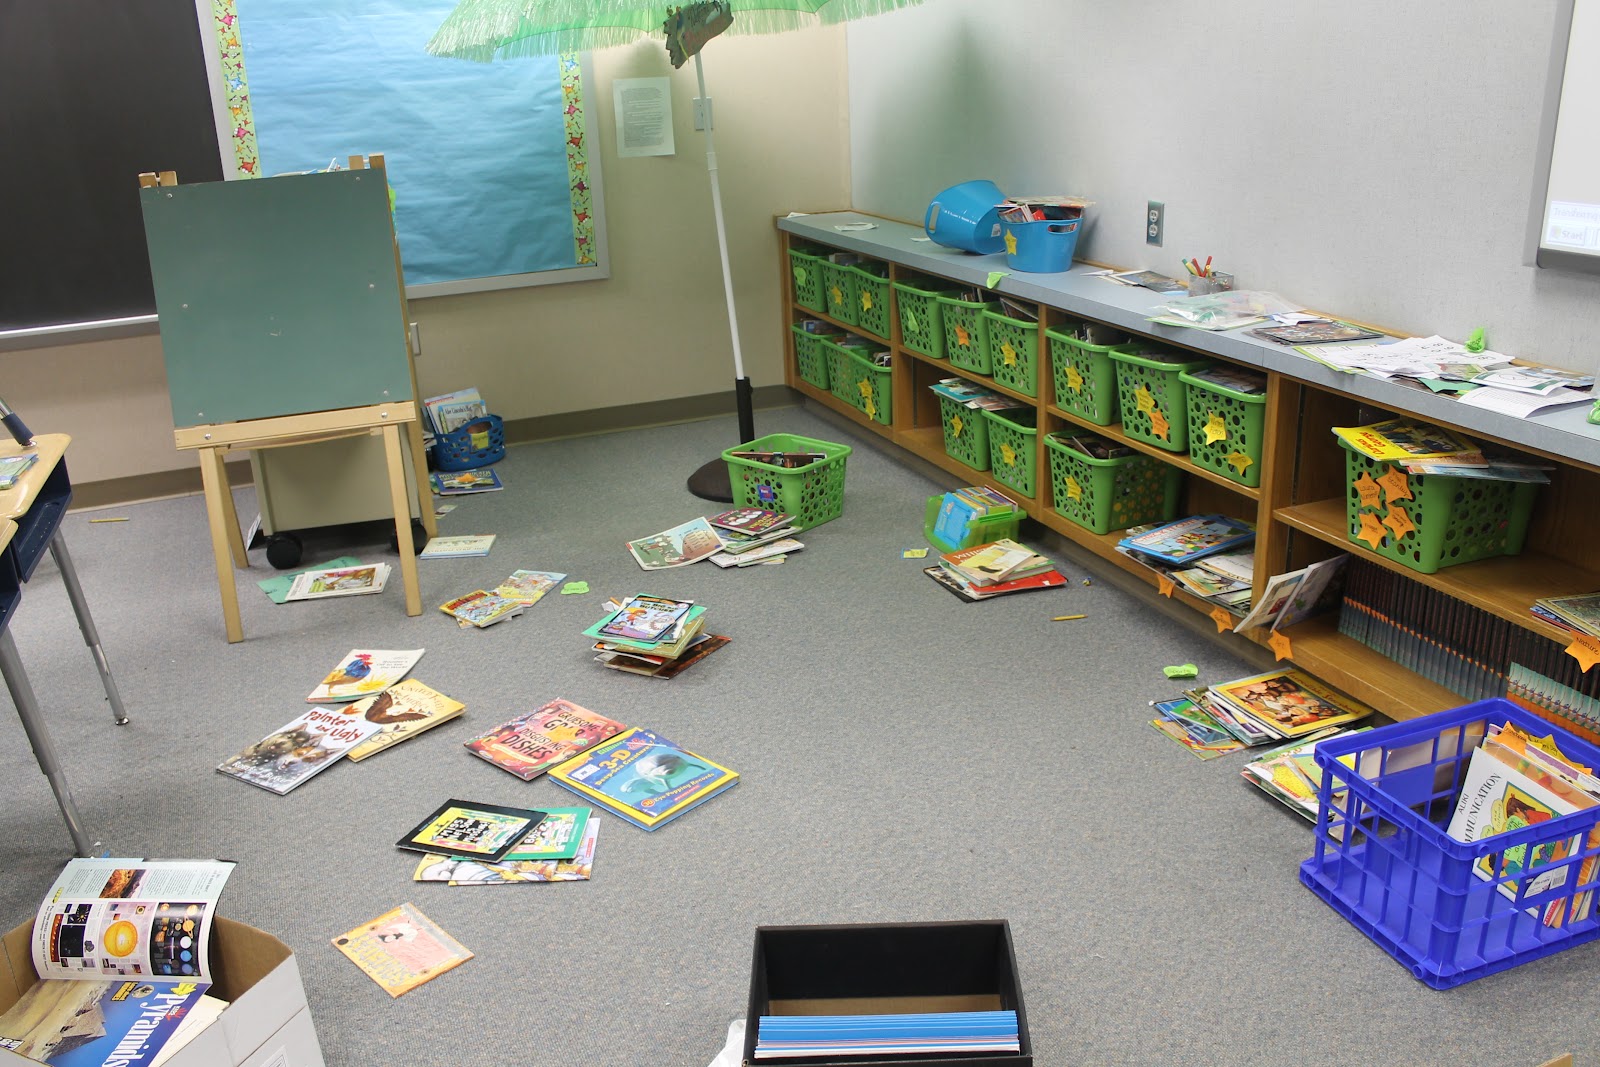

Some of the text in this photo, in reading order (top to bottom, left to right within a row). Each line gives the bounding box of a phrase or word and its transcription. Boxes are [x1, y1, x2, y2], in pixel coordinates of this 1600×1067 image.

[1561, 230, 1583, 241] Start
[303, 710, 356, 726] Painter
[558, 711, 602, 732] GRUESOME
[329, 727, 366, 743] Ugly
[499, 735, 553, 760] DISHES
[597, 748, 633, 770] 3-D
[1457, 793, 1470, 815] ALIKI
[1464, 772, 1502, 843] MMUNICATION
[439, 818, 465, 838] MISS
[102, 993, 191, 1067] Pyramids
